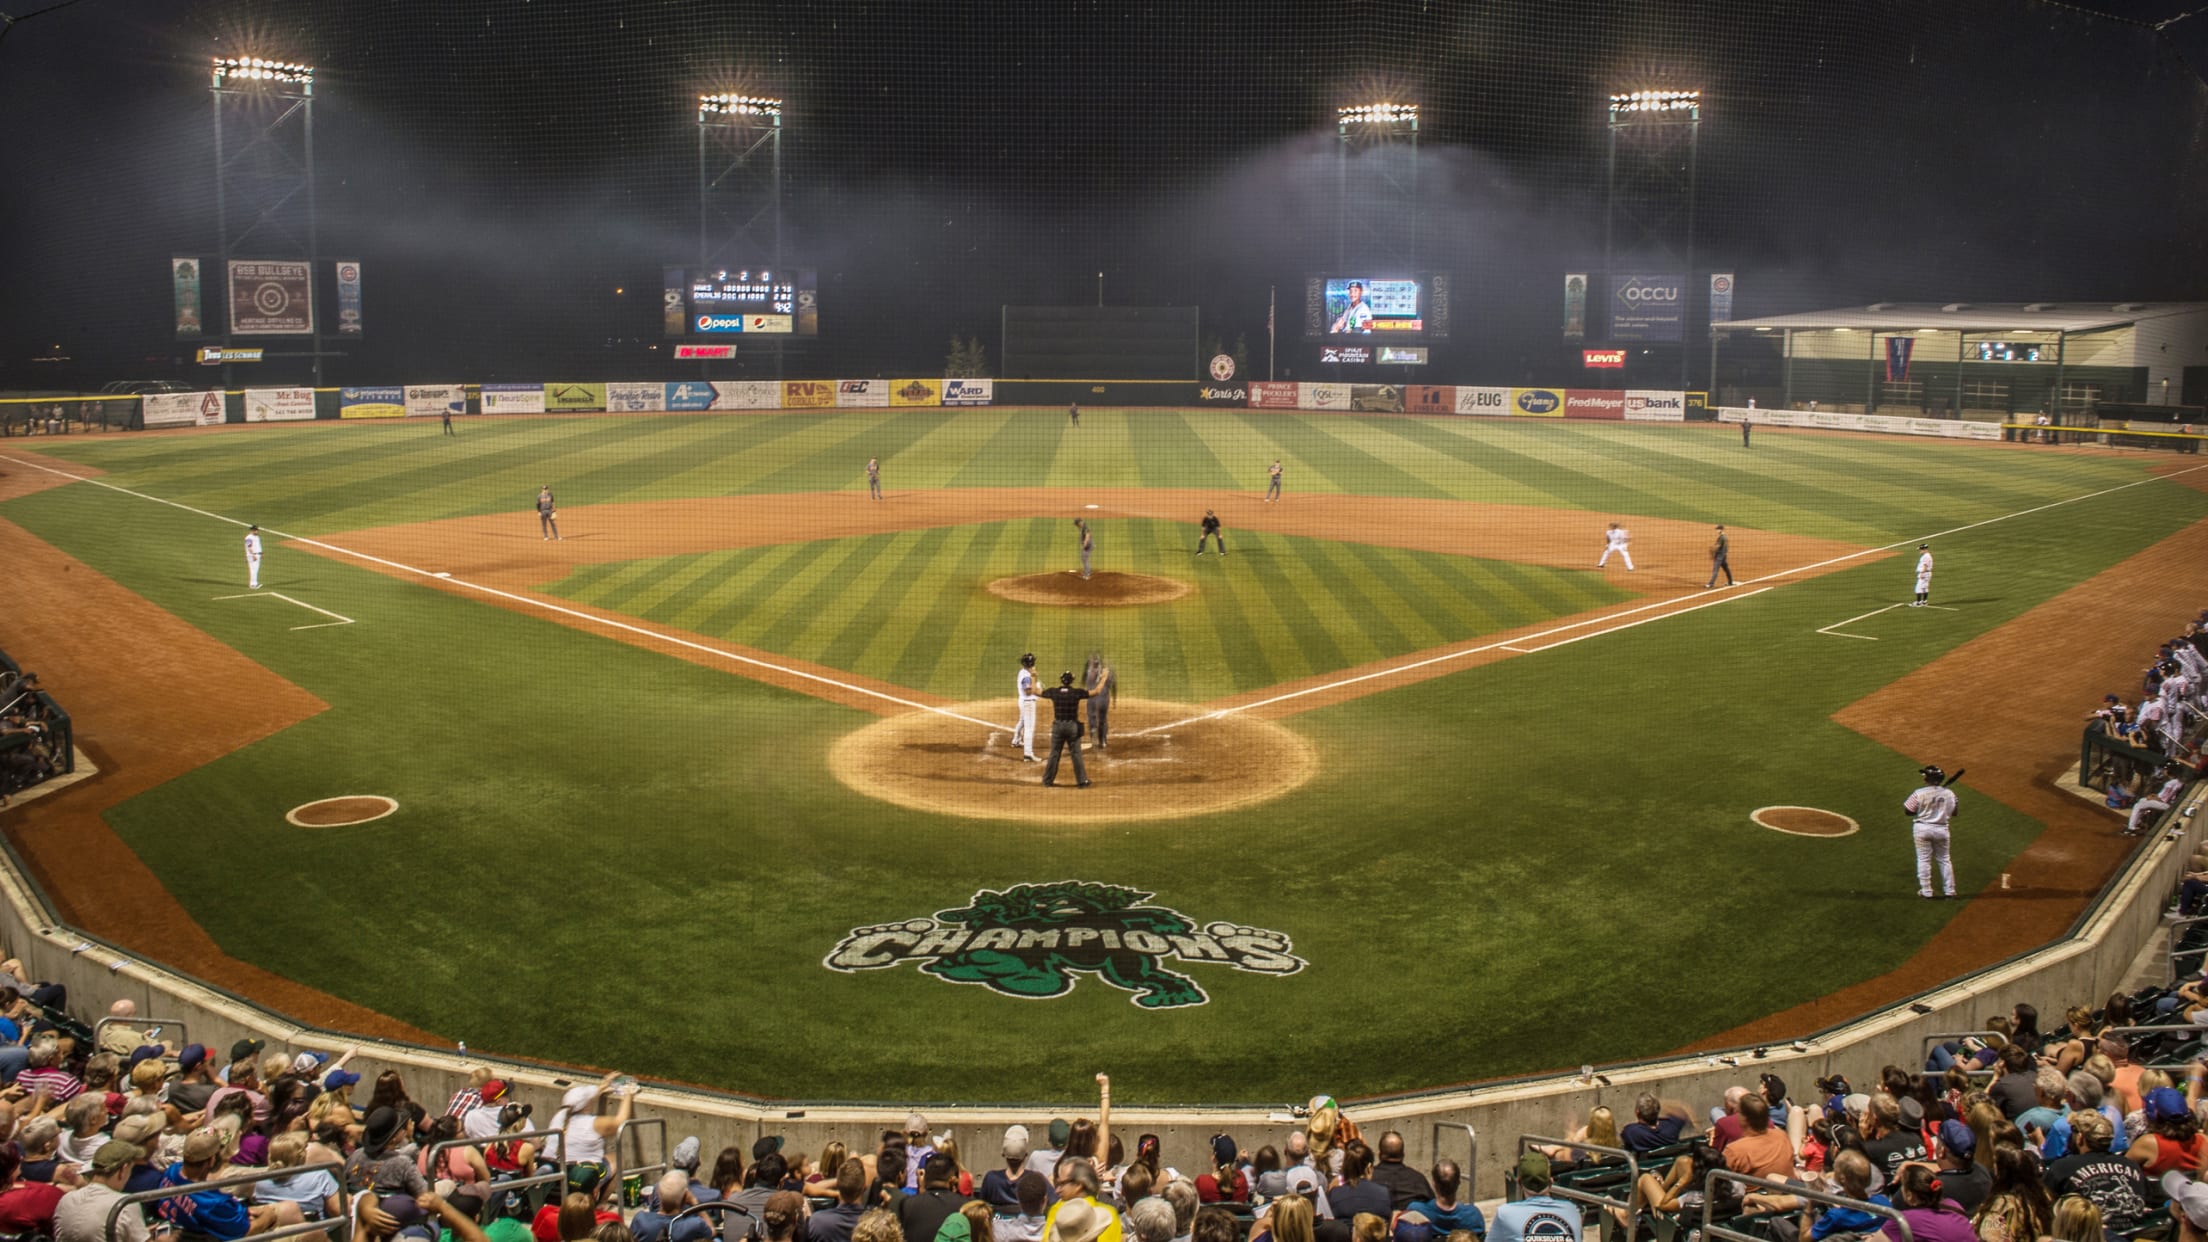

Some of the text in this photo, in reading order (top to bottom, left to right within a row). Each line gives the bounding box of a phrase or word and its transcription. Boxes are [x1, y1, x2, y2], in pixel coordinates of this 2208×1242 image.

[1626, 287, 1678, 300] OCCU
[712, 318, 740, 329] pepsi
[680, 347, 730, 357] BI-MART
[787, 382, 816, 396] RV
[949, 387, 983, 395] WARD
[1477, 393, 1502, 406] EUG
[831, 926, 1300, 970] CHAMPIONS
[2069, 1162, 2141, 1187] AMERICAN
